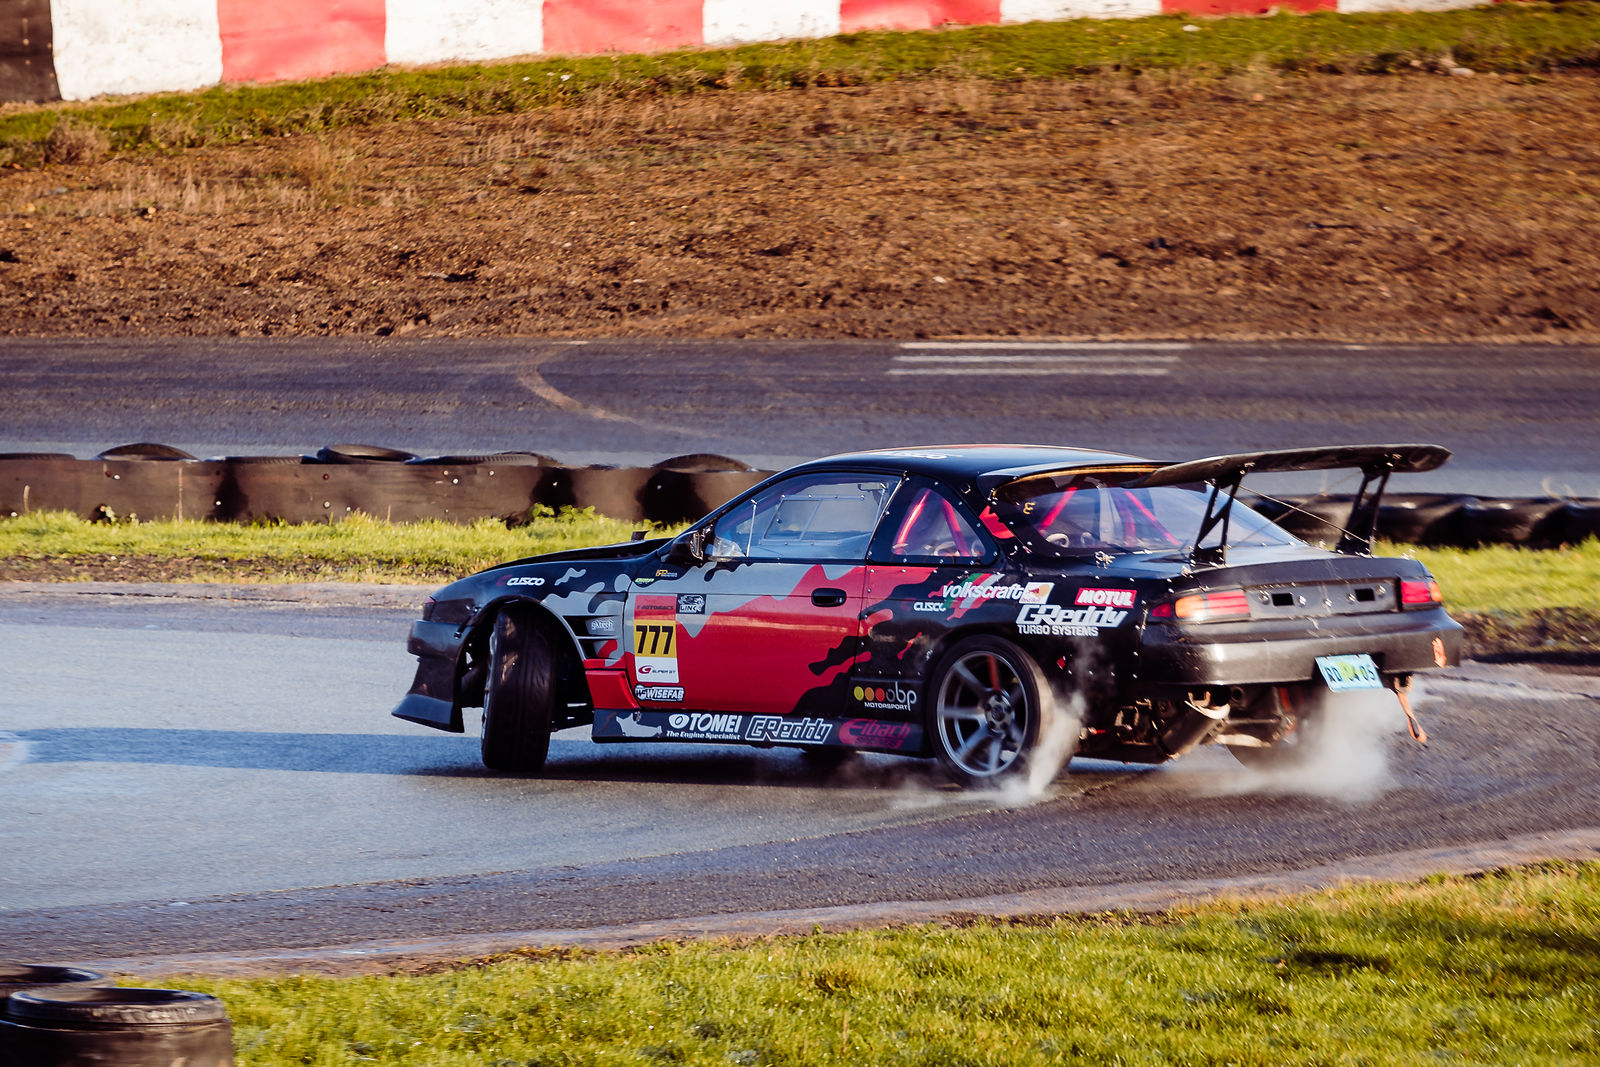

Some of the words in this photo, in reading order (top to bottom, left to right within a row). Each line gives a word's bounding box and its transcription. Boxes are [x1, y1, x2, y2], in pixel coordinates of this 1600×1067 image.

[506, 577, 545, 586] CUSCO
[942, 581, 1025, 600] volkscraft
[1077, 589, 1132, 606] MOTUL
[1016, 604, 1128, 628] GReddy
[1017, 624, 1050, 635] TURBO
[1052, 625, 1098, 637] SYSTEMS
[636, 625, 674, 654] 777
[646, 688, 684, 699] WISEFAB
[886, 681, 917, 711] obp
[864, 701, 908, 710] MOTORSPORT
[689, 713, 742, 733] TOMEI
[666, 730, 679, 738] The
[680, 731, 704, 739] Engine
[705, 732, 741, 740] Specialist
